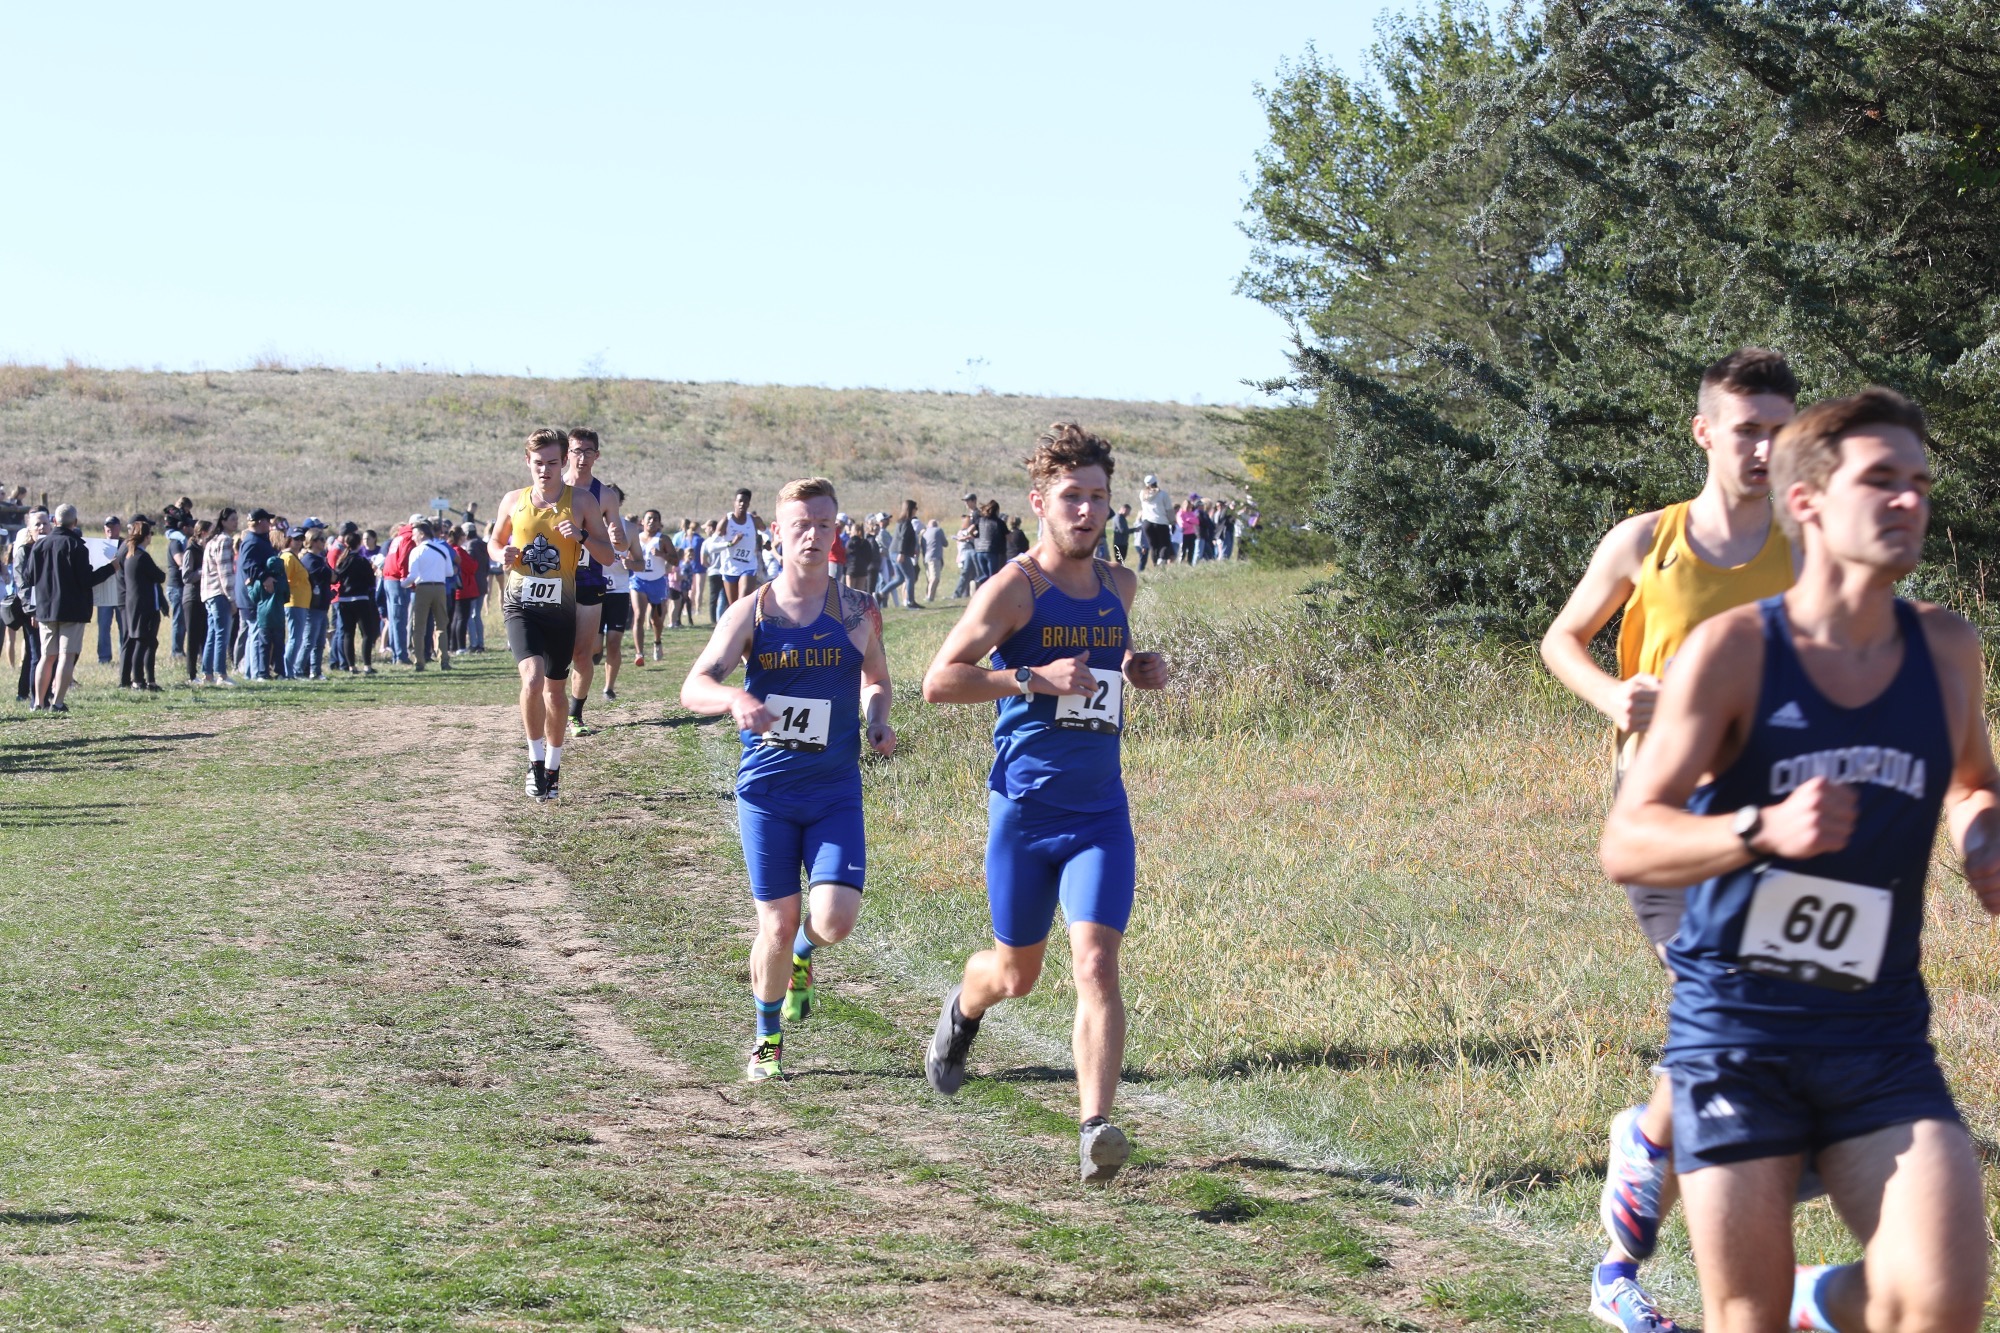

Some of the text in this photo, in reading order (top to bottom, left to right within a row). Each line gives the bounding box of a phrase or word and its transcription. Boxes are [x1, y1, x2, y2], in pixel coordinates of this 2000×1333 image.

[735, 548, 751, 558] 287
[529, 582, 556, 599] 107
[1042, 626, 1124, 648] BRIAR CLIFF
[758, 648, 843, 670] BRIAR CLIFF
[781, 706, 811, 734] 14
[1769, 745, 1926, 800] CONCORDIA
[1781, 894, 1857, 951] 60
